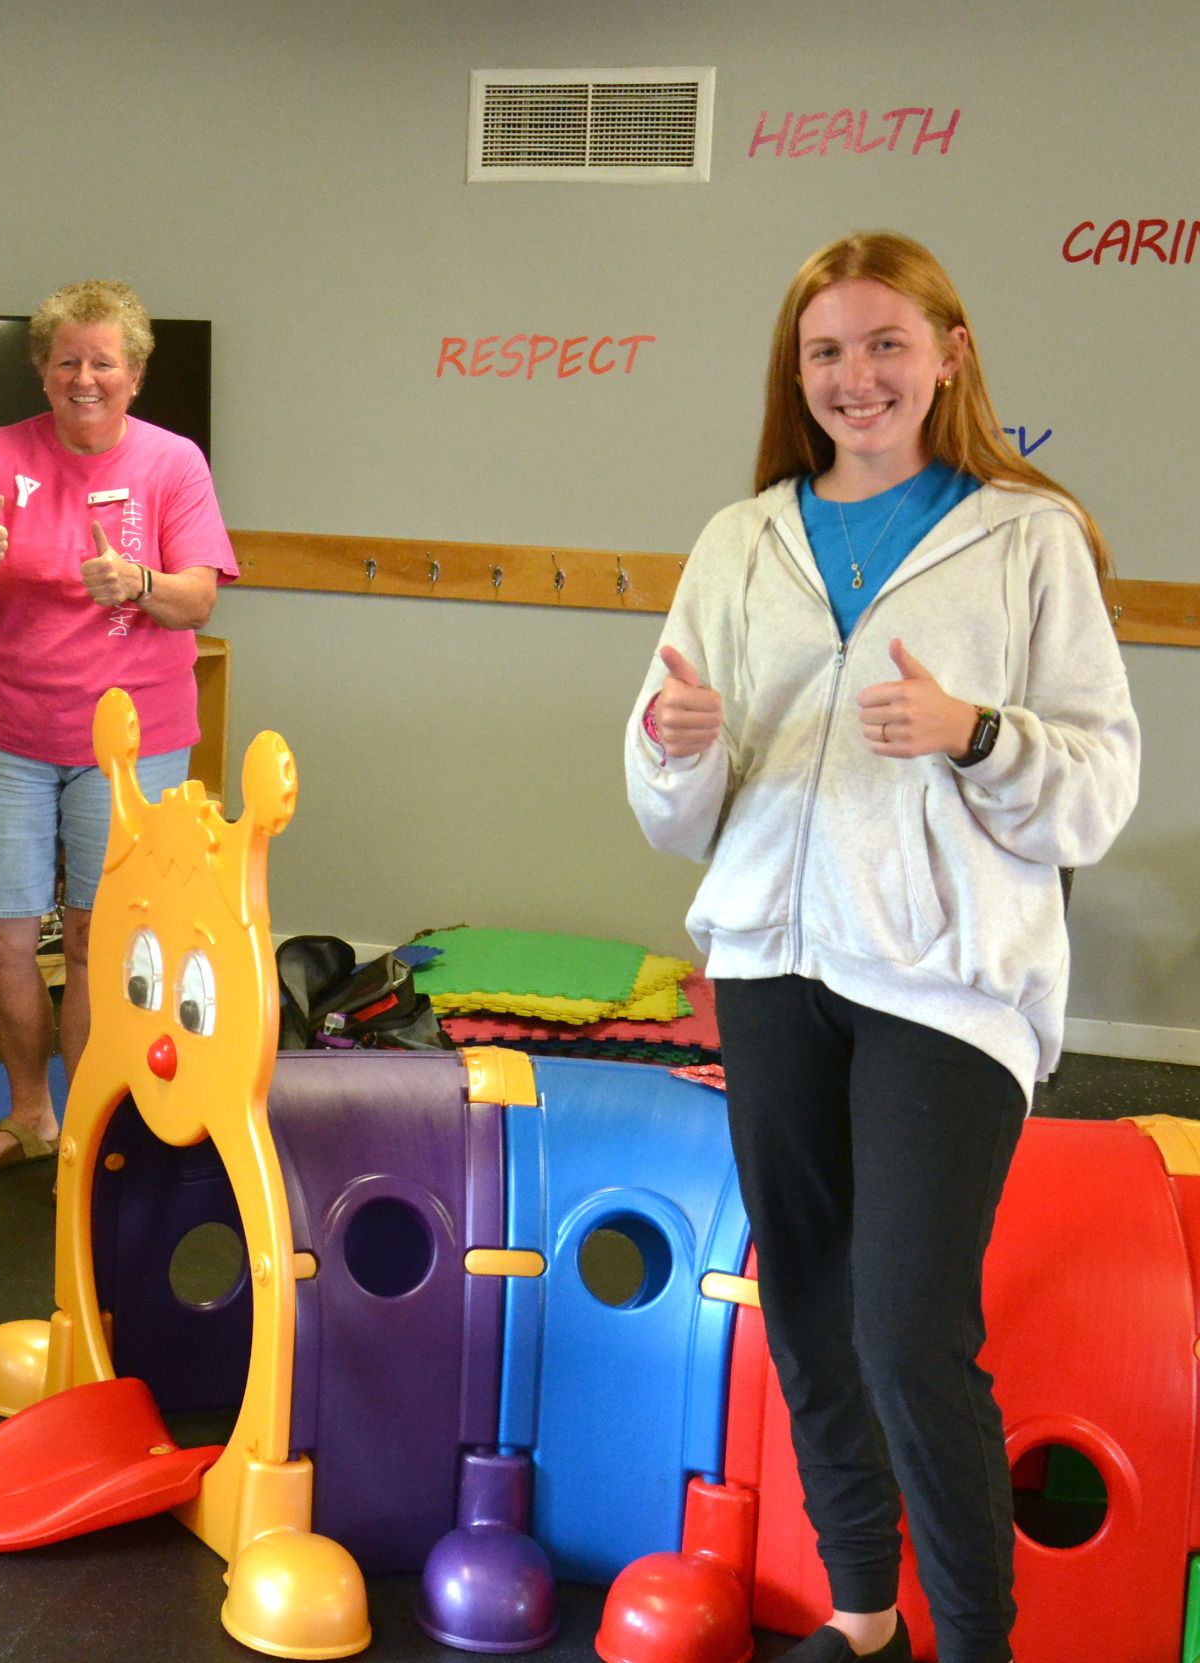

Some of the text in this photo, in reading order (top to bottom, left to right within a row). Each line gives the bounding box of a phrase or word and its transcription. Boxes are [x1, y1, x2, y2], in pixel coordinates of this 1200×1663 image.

[748, 107, 962, 158] HEALTH
[435, 333, 657, 380] RESPECT
[108, 605, 141, 637] DAY
